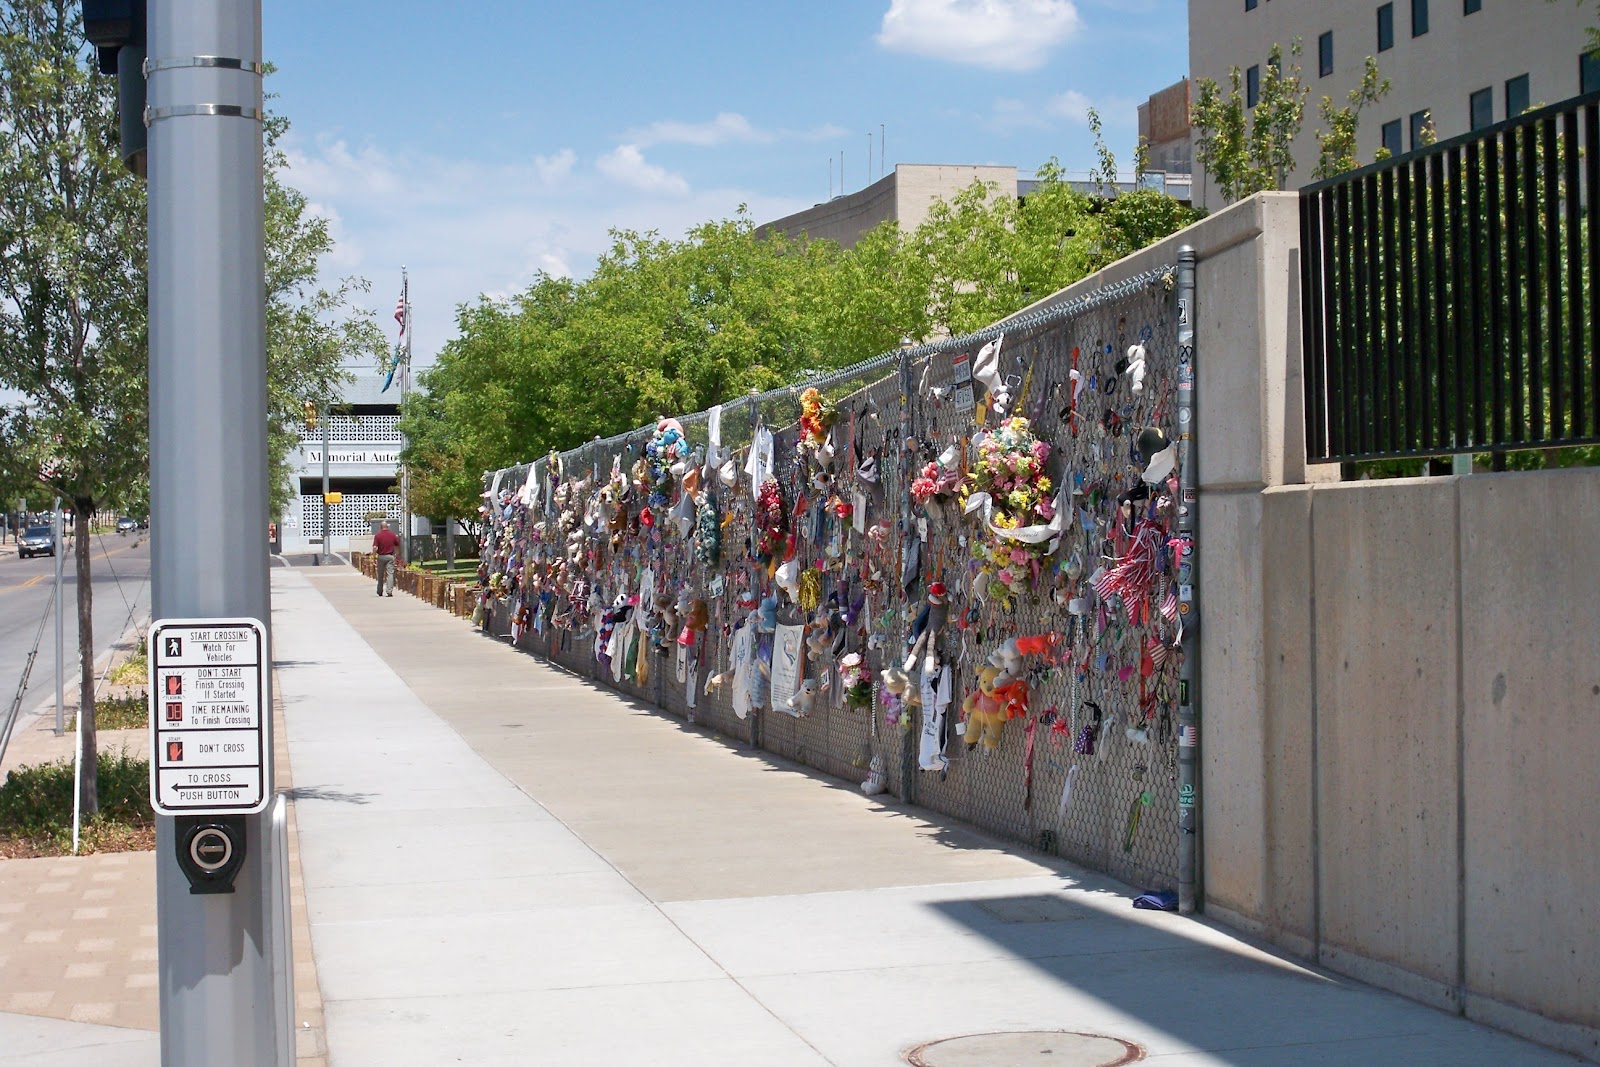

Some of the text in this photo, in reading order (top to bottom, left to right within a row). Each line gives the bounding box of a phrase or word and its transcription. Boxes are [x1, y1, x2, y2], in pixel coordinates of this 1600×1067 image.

[310, 452, 366, 462] Mmorial
[190, 631, 248, 641] START CROSSING
[202, 643, 236, 652] Watch For
[206, 653, 233, 662] Vehicles
[197, 668, 242, 678] DON'T START
[195, 680, 245, 690] Finish Crossing
[204, 690, 236, 699] If Started
[191, 704, 250, 715] TIME REMAINING
[191, 716, 251, 726] To Finish Crossing
[199, 743, 245, 753] DON'T CROSS
[188, 773, 232, 783] TO CROSS
[180, 790, 240, 800] PUSH BUTTON
